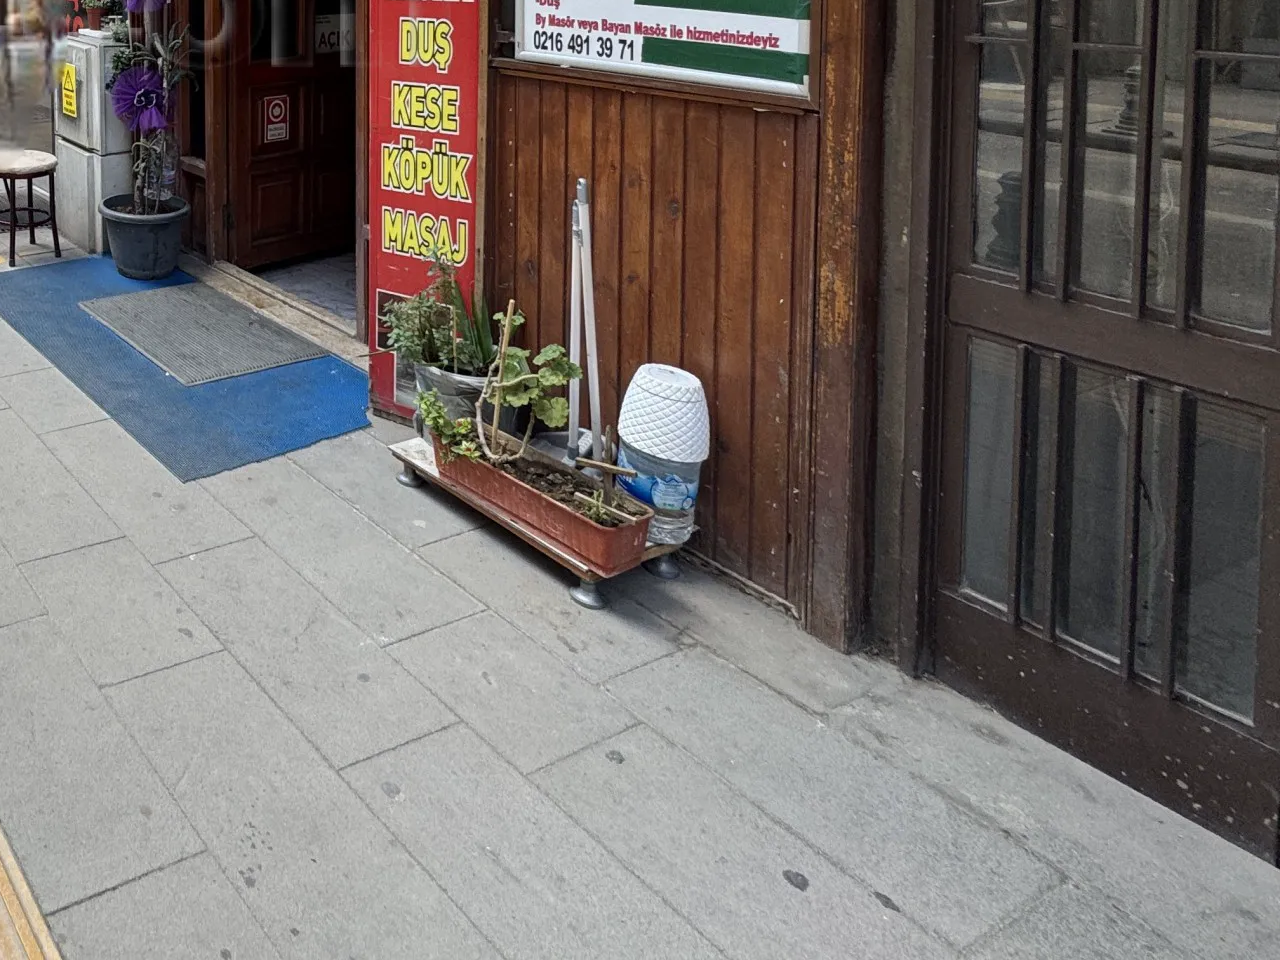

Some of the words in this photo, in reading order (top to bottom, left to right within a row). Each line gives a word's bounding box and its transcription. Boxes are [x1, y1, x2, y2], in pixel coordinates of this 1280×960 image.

[399, 16, 454, 73] DUŞ
[534, 31, 563, 52] 0216
[568, 34, 589, 55] 491
[596, 37, 613, 58] 39
[619, 39, 634, 60] 71
[535, 13, 546, 28] By
[548, 14, 575, 28] Masör
[577, 20, 599, 33] veya
[601, 19, 631, 35] Bayan
[634, 22, 667, 37] Masöz
[670, 24, 683, 38] ile
[686, 26, 779, 49] hizmetinizdeyiz
[391, 80, 460, 135] KESE
[381, 134, 473, 203] KÖPÜK
[382, 206, 468, 267] MASAJ
